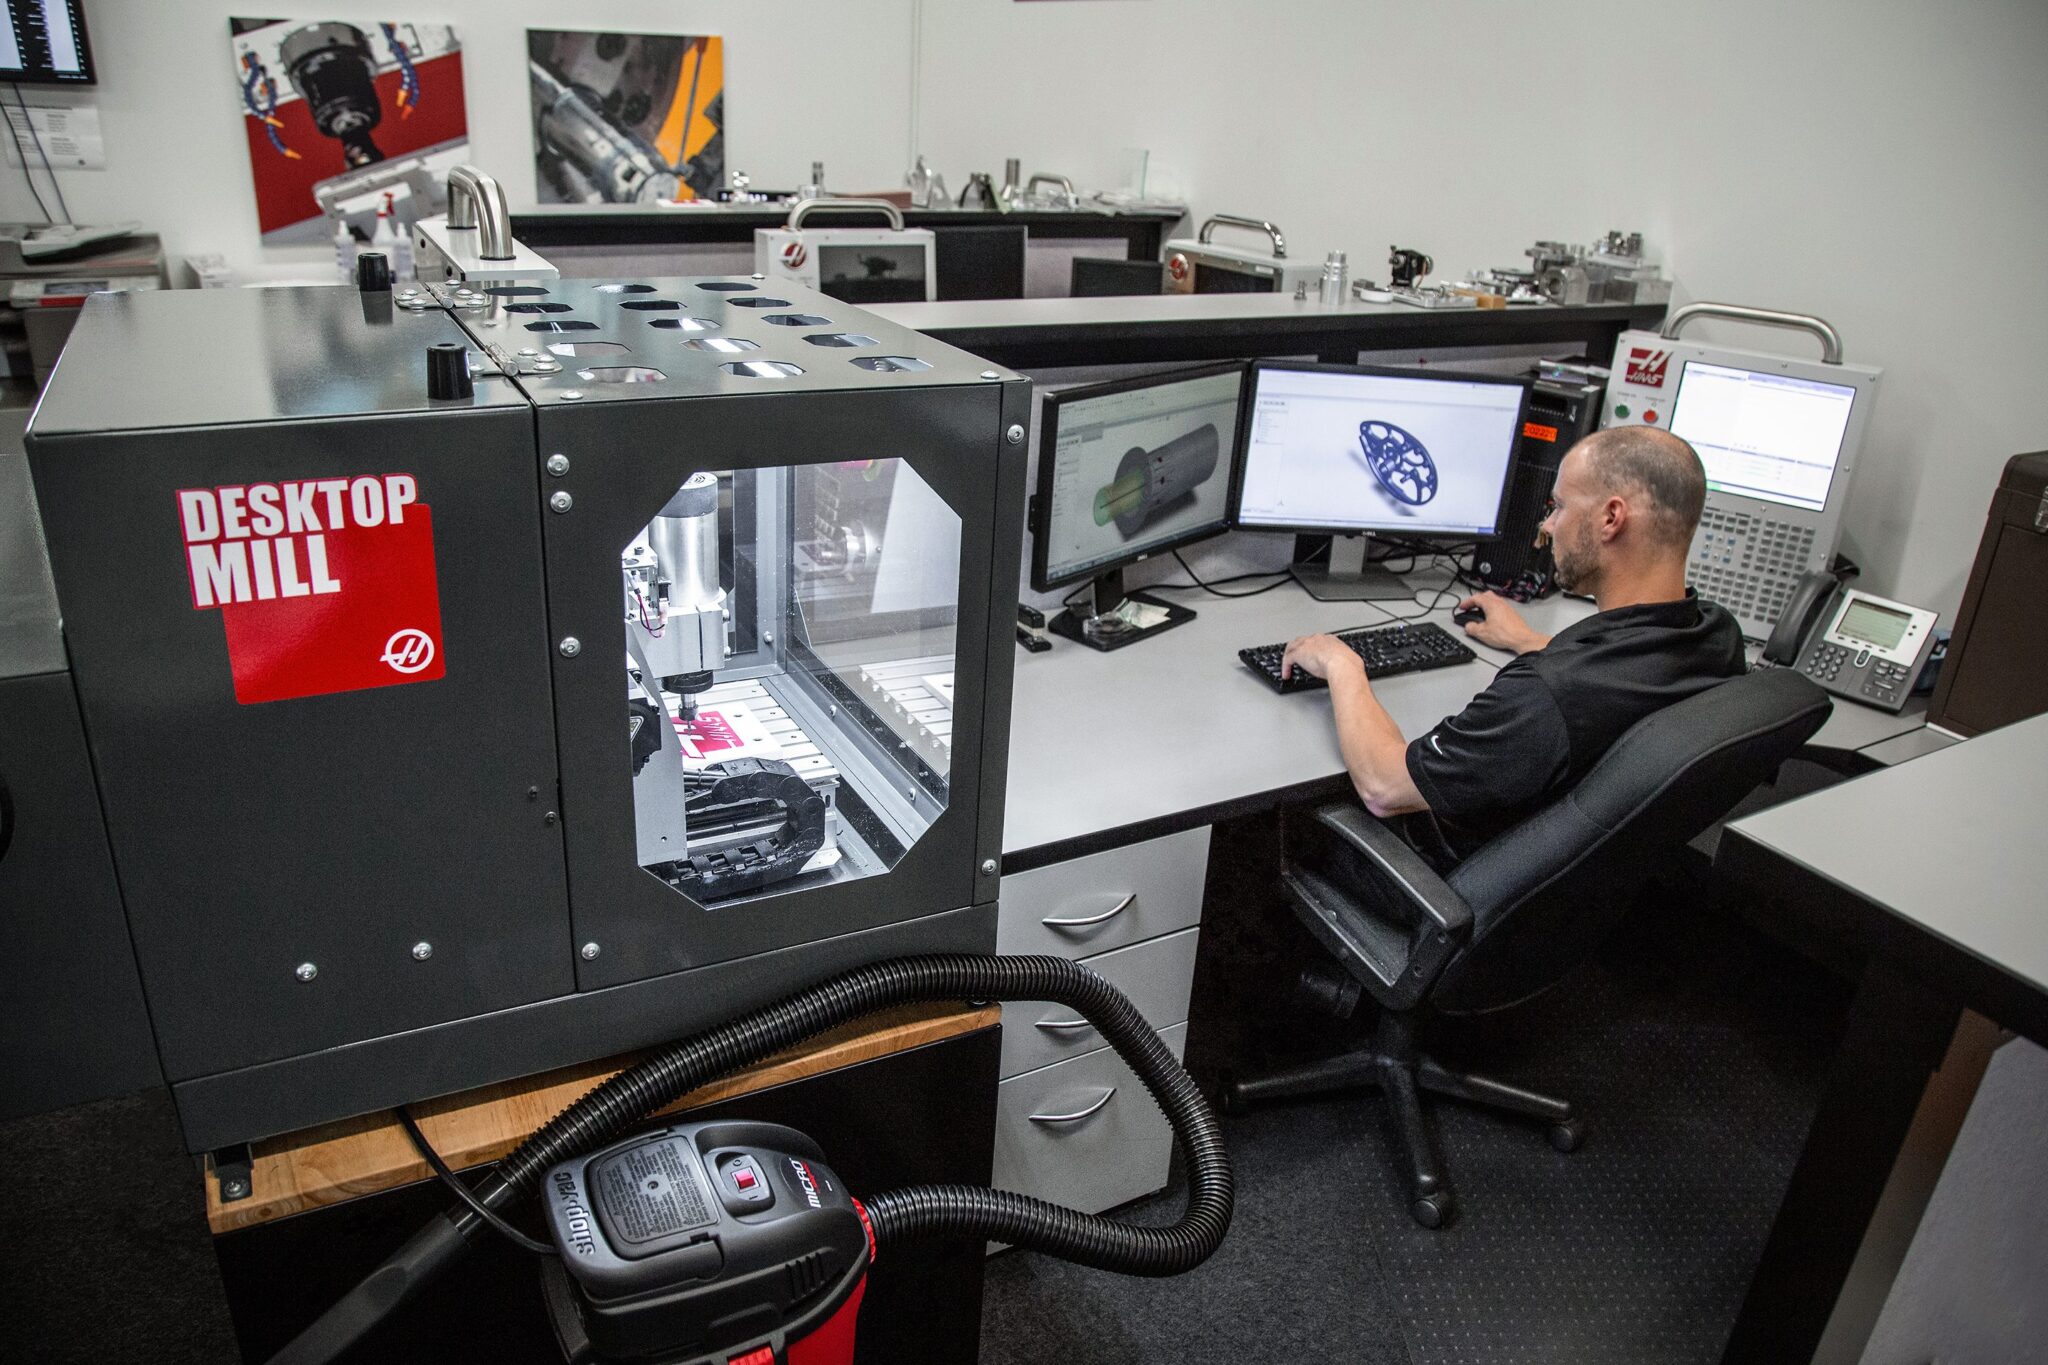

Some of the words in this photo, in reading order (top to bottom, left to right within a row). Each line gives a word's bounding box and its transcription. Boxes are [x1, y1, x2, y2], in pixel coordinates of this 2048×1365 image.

[179, 474, 417, 543] DESKTOP
[188, 534, 342, 607] MILL
[790, 1159, 822, 1209] MICRO
